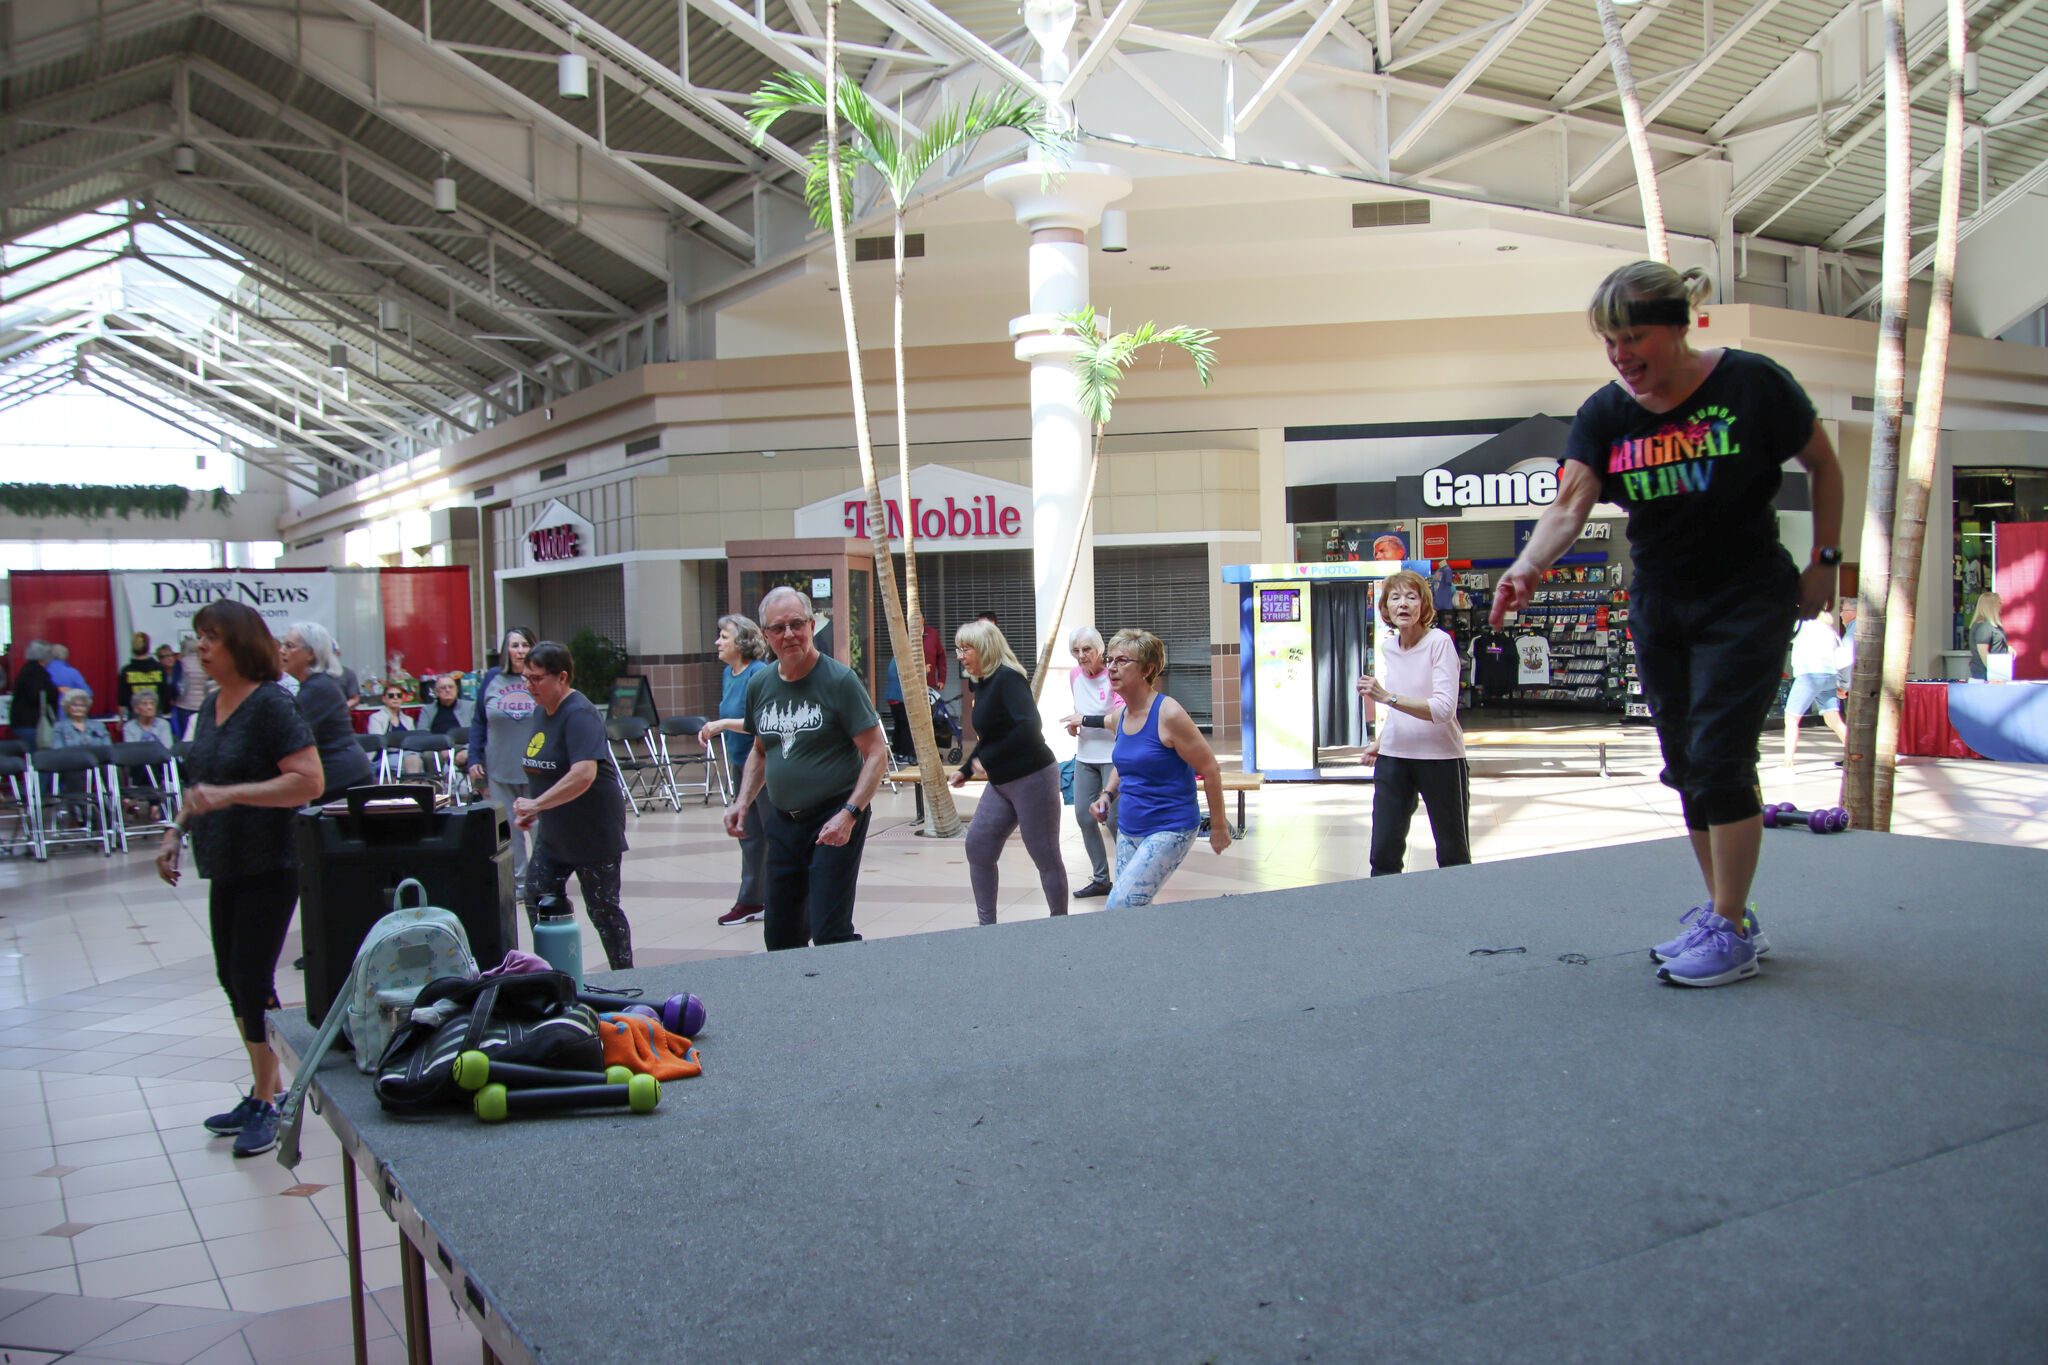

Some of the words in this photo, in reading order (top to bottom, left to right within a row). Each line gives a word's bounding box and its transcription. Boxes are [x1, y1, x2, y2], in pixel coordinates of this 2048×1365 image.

[1688, 406, 1737, 425] ZUMBA
[1423, 467, 1564, 507] Game
[1622, 460, 1714, 500] FLOW
[844, 496, 1021, 539] TMobile
[1311, 565, 1358, 575] PHOTOS
[235, 582, 309, 605] NEWS
[1262, 602, 1290, 612] SIZE
[499, 683, 529, 695] DETRO
